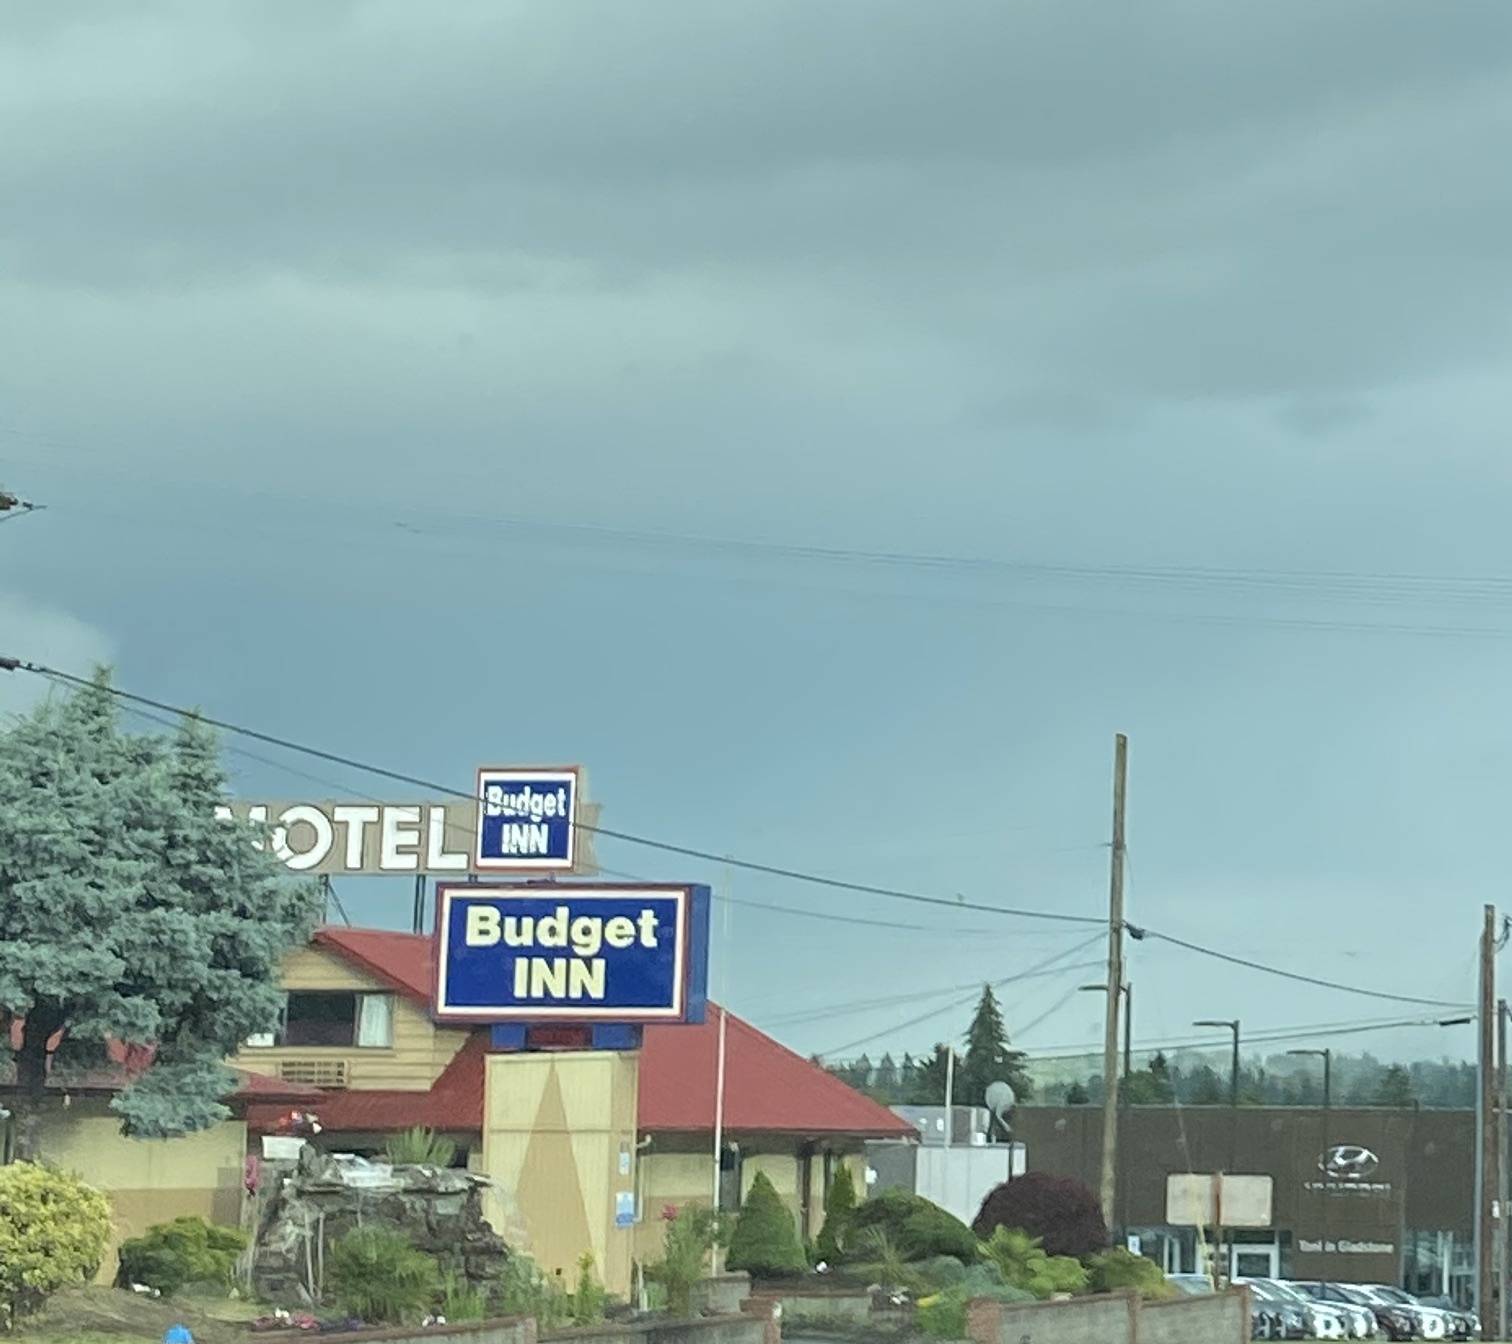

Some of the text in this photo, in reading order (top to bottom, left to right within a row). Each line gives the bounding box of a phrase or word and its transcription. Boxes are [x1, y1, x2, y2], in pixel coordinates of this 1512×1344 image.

[485, 785, 566, 823] Budget
[501, 823, 549, 854] INN
[466, 905, 659, 956] Budget
[513, 957, 606, 999] INN
